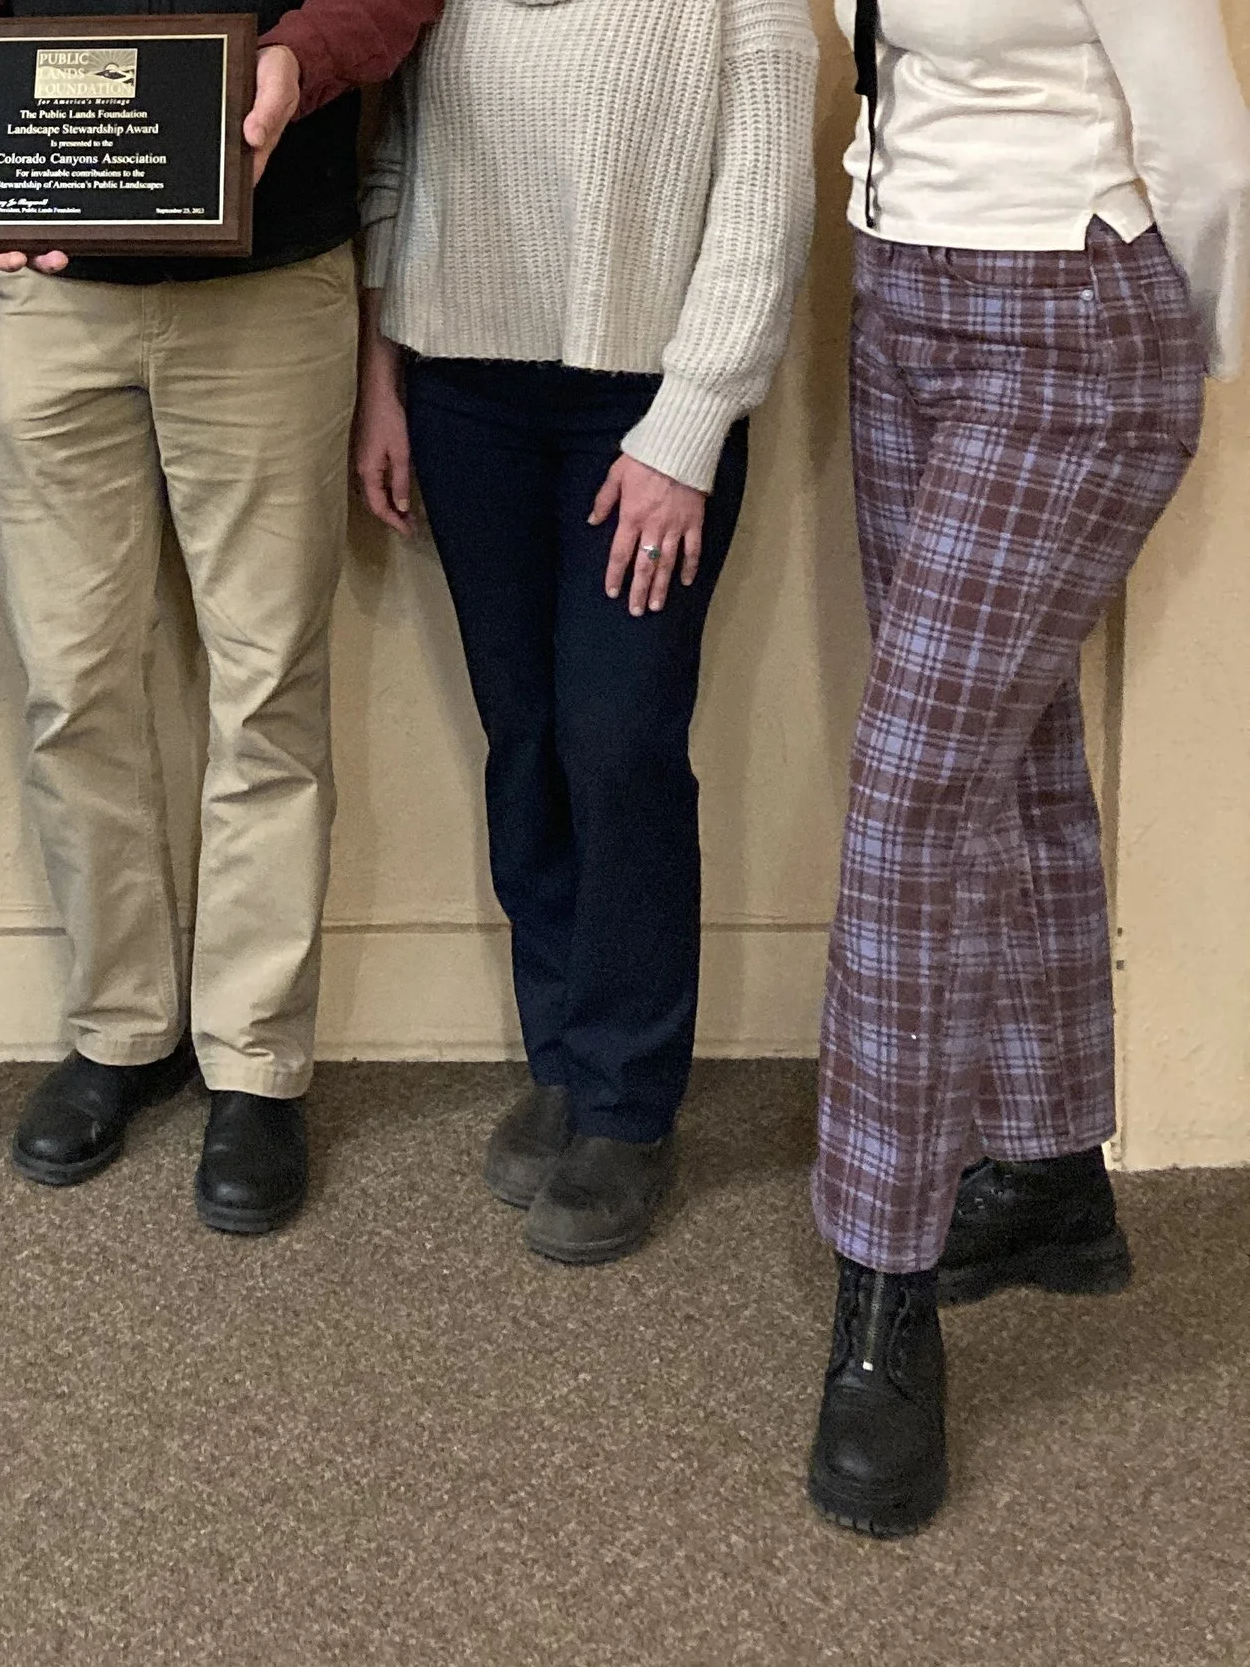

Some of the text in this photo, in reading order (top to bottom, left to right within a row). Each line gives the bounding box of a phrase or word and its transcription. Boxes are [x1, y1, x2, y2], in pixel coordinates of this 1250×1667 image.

[39, 52, 90, 65] PUBLIC
[38, 67, 86, 80] LANDS
[37, 82, 133, 95] FOUNDATION
[95, 98, 130, 106] Heritage
[20, 109, 148, 119] The Public Lands Foundation
[7, 123, 159, 137] Landscape Stewardship Award
[58, 139, 92, 149] presented
[101, 139, 114, 147] the
[50, 152, 99, 166] Canyons
[101, 152, 167, 164] Association
[15, 168, 145, 178] For invaluable contributions to the
[43, 180, 53, 189] of
[53, 180, 92, 189] America's
[93, 180, 118, 189] Public
[119, 180, 164, 191] Landscapes
